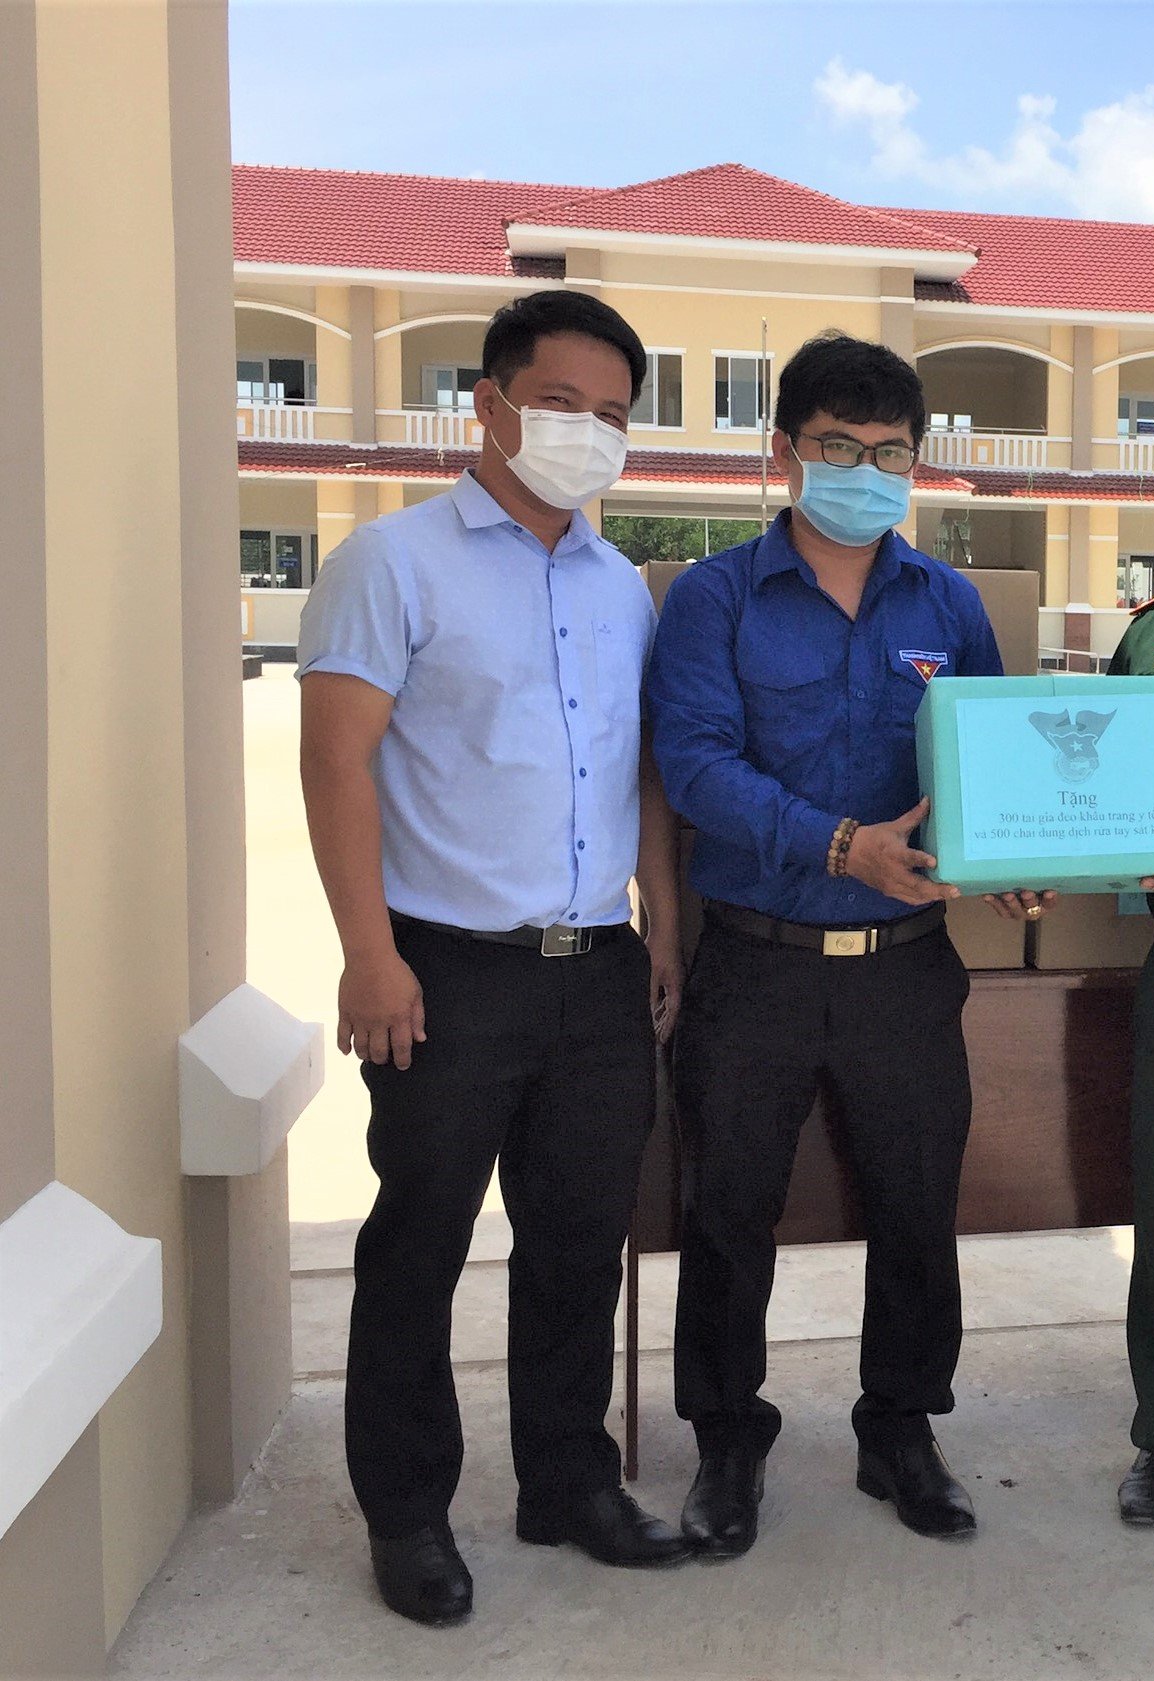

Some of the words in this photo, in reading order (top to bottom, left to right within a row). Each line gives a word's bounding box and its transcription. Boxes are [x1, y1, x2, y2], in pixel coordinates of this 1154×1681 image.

[1057, 791, 1097, 808] Tặng
[1000, 813, 1019, 823] 300
[1108, 812, 1136, 823] trang
[1138, 813, 1146, 822] y
[990, 828, 1011, 839] 500
[1039, 827, 1065, 840] dung
[1068, 826, 1091, 839] dịch
[1114, 827, 1130, 838] tay
